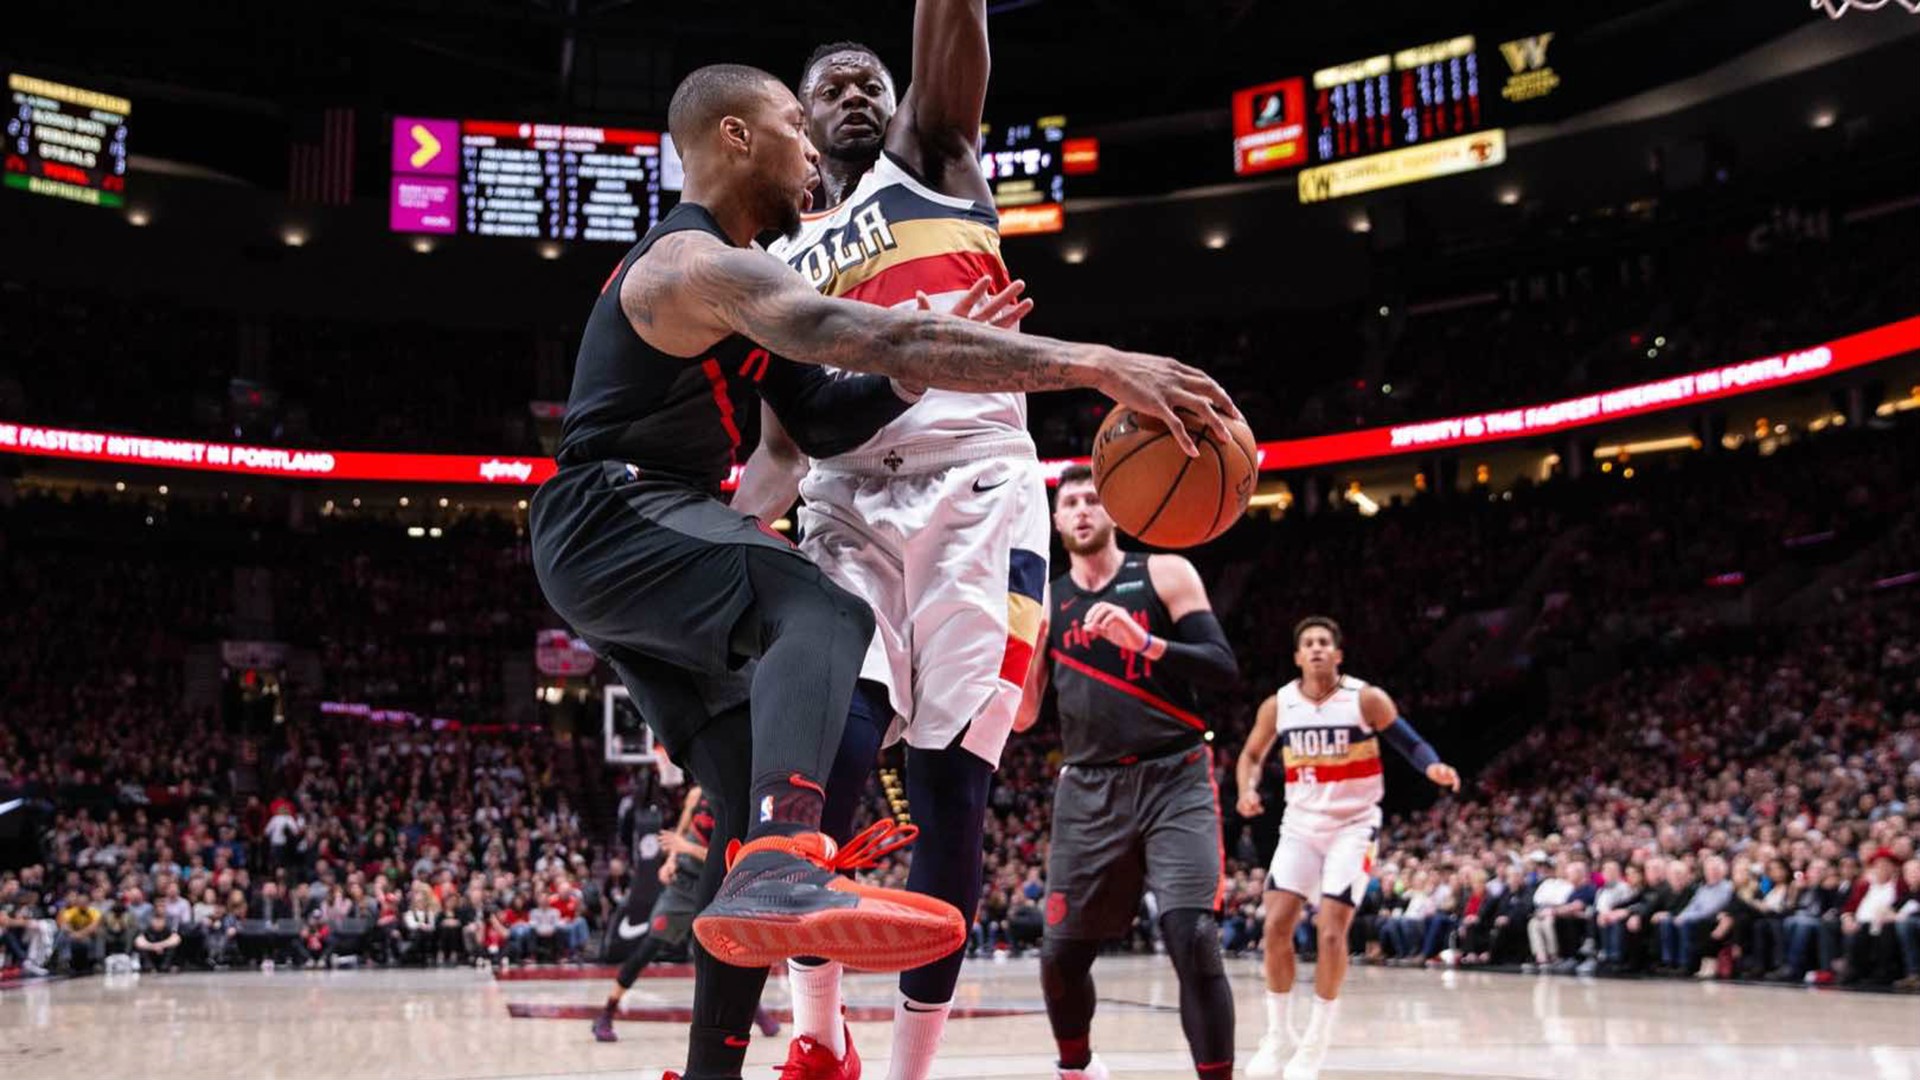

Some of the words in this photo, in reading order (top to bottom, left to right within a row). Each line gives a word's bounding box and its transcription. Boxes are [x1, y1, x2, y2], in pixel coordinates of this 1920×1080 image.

[788, 201, 898, 292] OLA
[1696, 371, 1720, 394] IN
[1721, 346, 1832, 387] PORTLAND
[20, 427, 105, 454] FASTEST
[107, 436, 204, 462] INTERNET
[206, 444, 229, 465] IN
[231, 446, 335, 473] PORTLAND
[1289, 728, 1350, 758] NOLA
